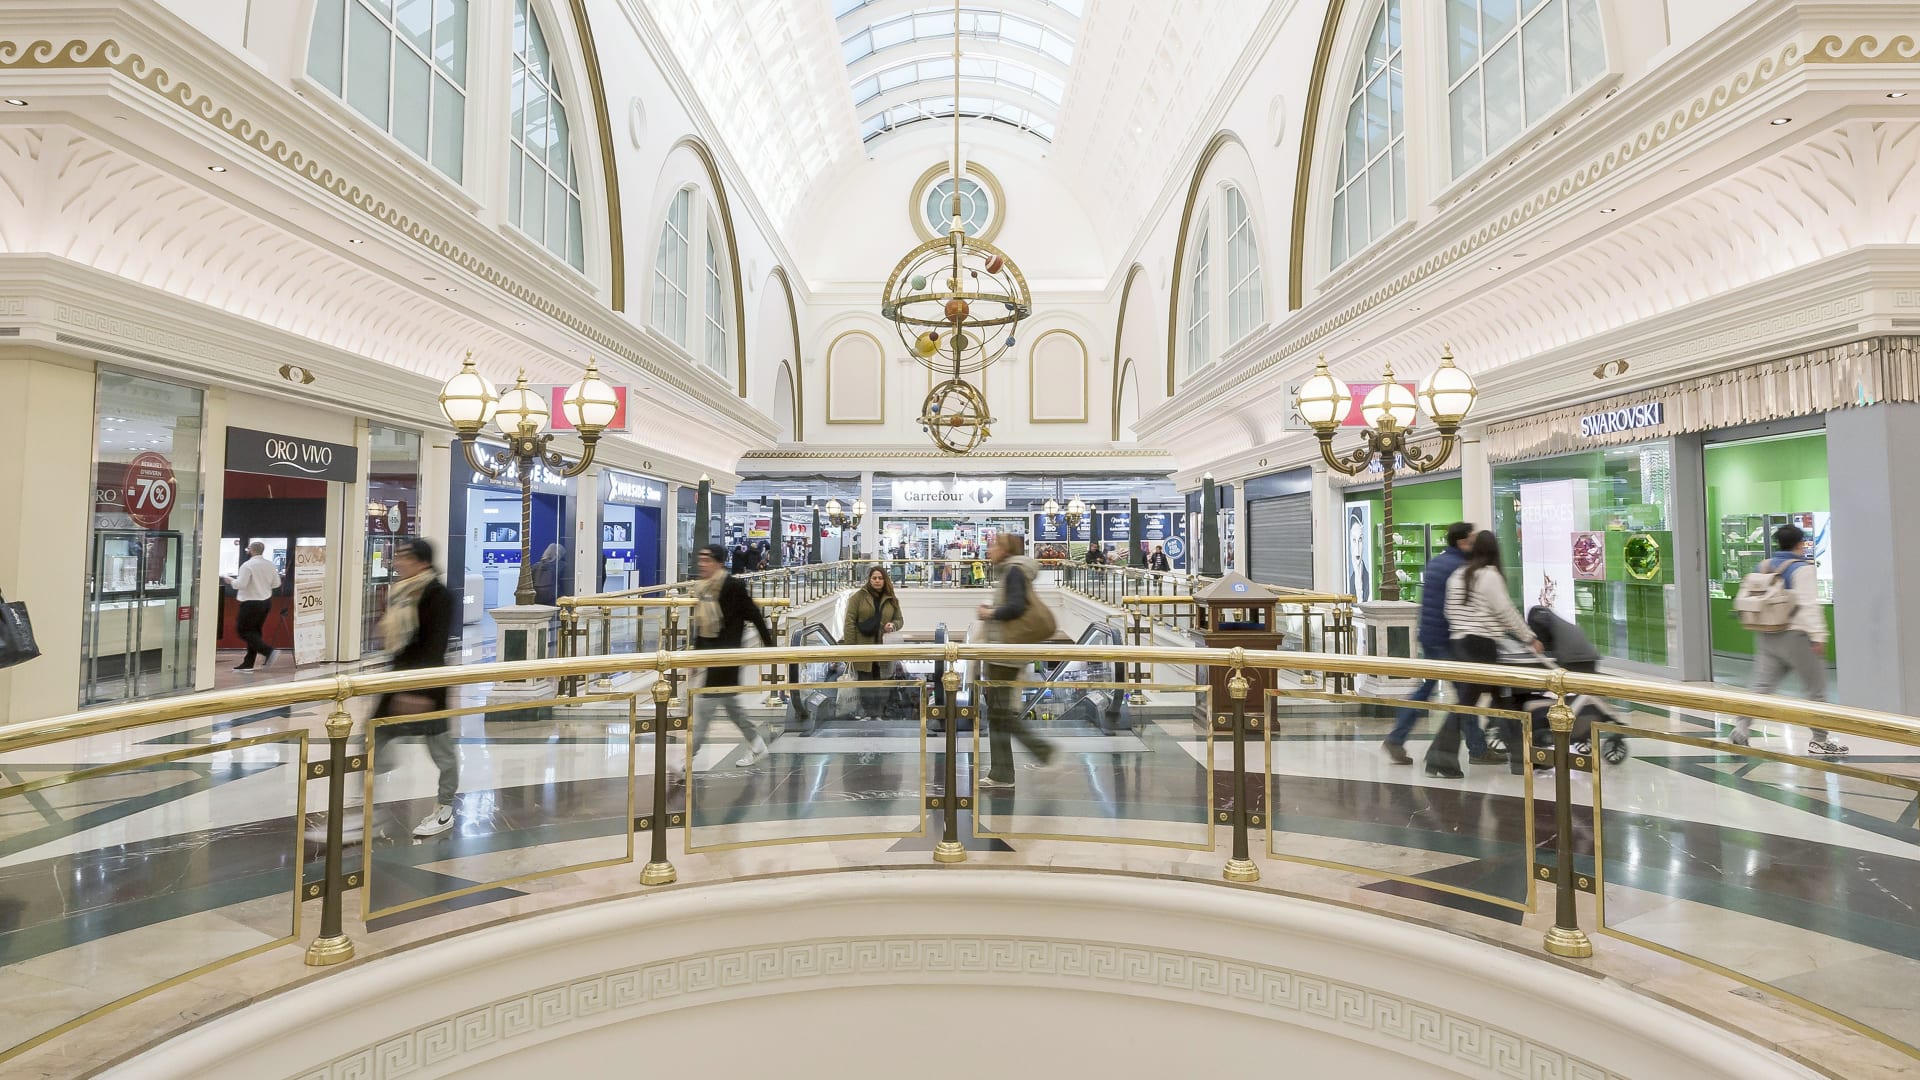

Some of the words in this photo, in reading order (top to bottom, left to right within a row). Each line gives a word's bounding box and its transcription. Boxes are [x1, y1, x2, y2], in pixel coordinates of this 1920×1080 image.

[1581, 402, 1661, 437] SWAROVSKI
[265, 439, 298, 461] ORO
[301, 443, 332, 466] VIVO
[904, 490, 964, 502] Carrefour
[298, 595, 322, 608] -20%
